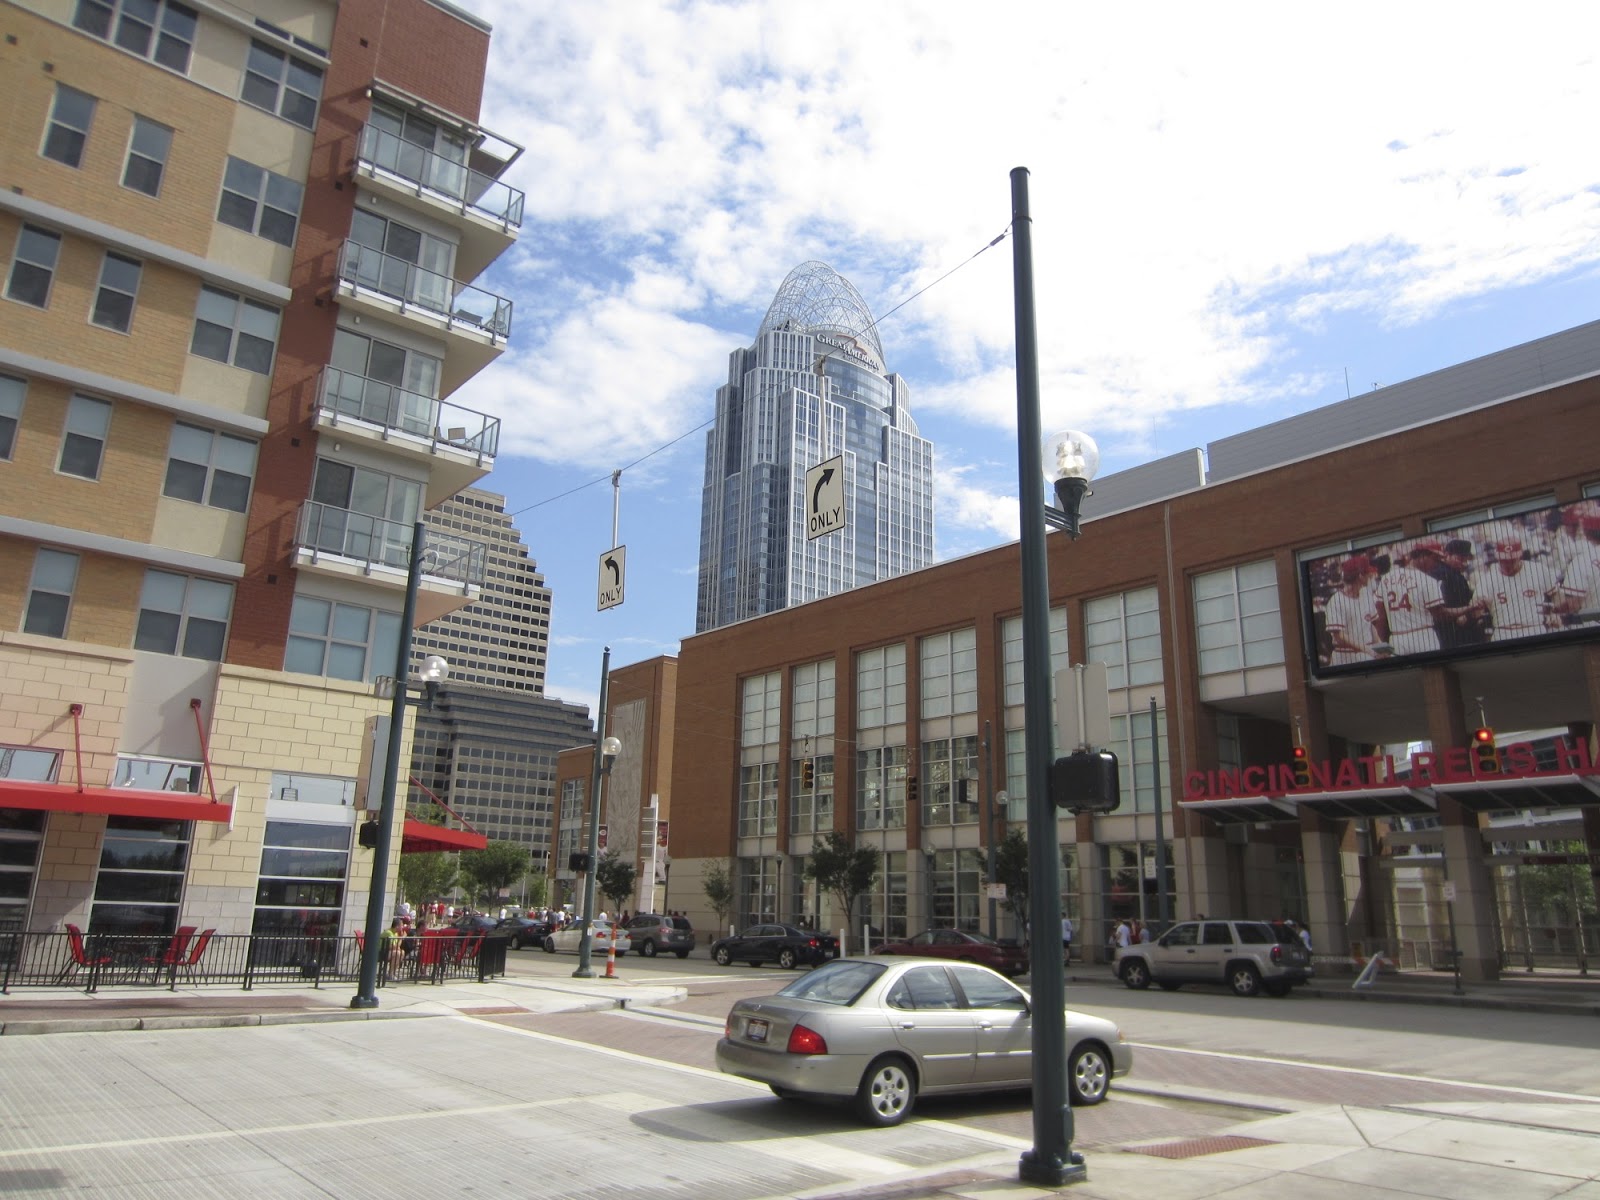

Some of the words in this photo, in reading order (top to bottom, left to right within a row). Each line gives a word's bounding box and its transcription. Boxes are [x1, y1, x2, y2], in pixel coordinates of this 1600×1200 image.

[816, 333, 847, 351] GREAT
[844, 346, 880, 371] AMERICAN
[810, 507, 841, 532] ONLY
[599, 587, 622, 605] ONLY
[1387, 588, 1412, 613] 24
[1497, 592, 1507, 605] 5
[1184, 754, 1395, 797] CINCINNATI
[1409, 742, 1538, 787] RES
[1553, 735, 1600, 772] H
